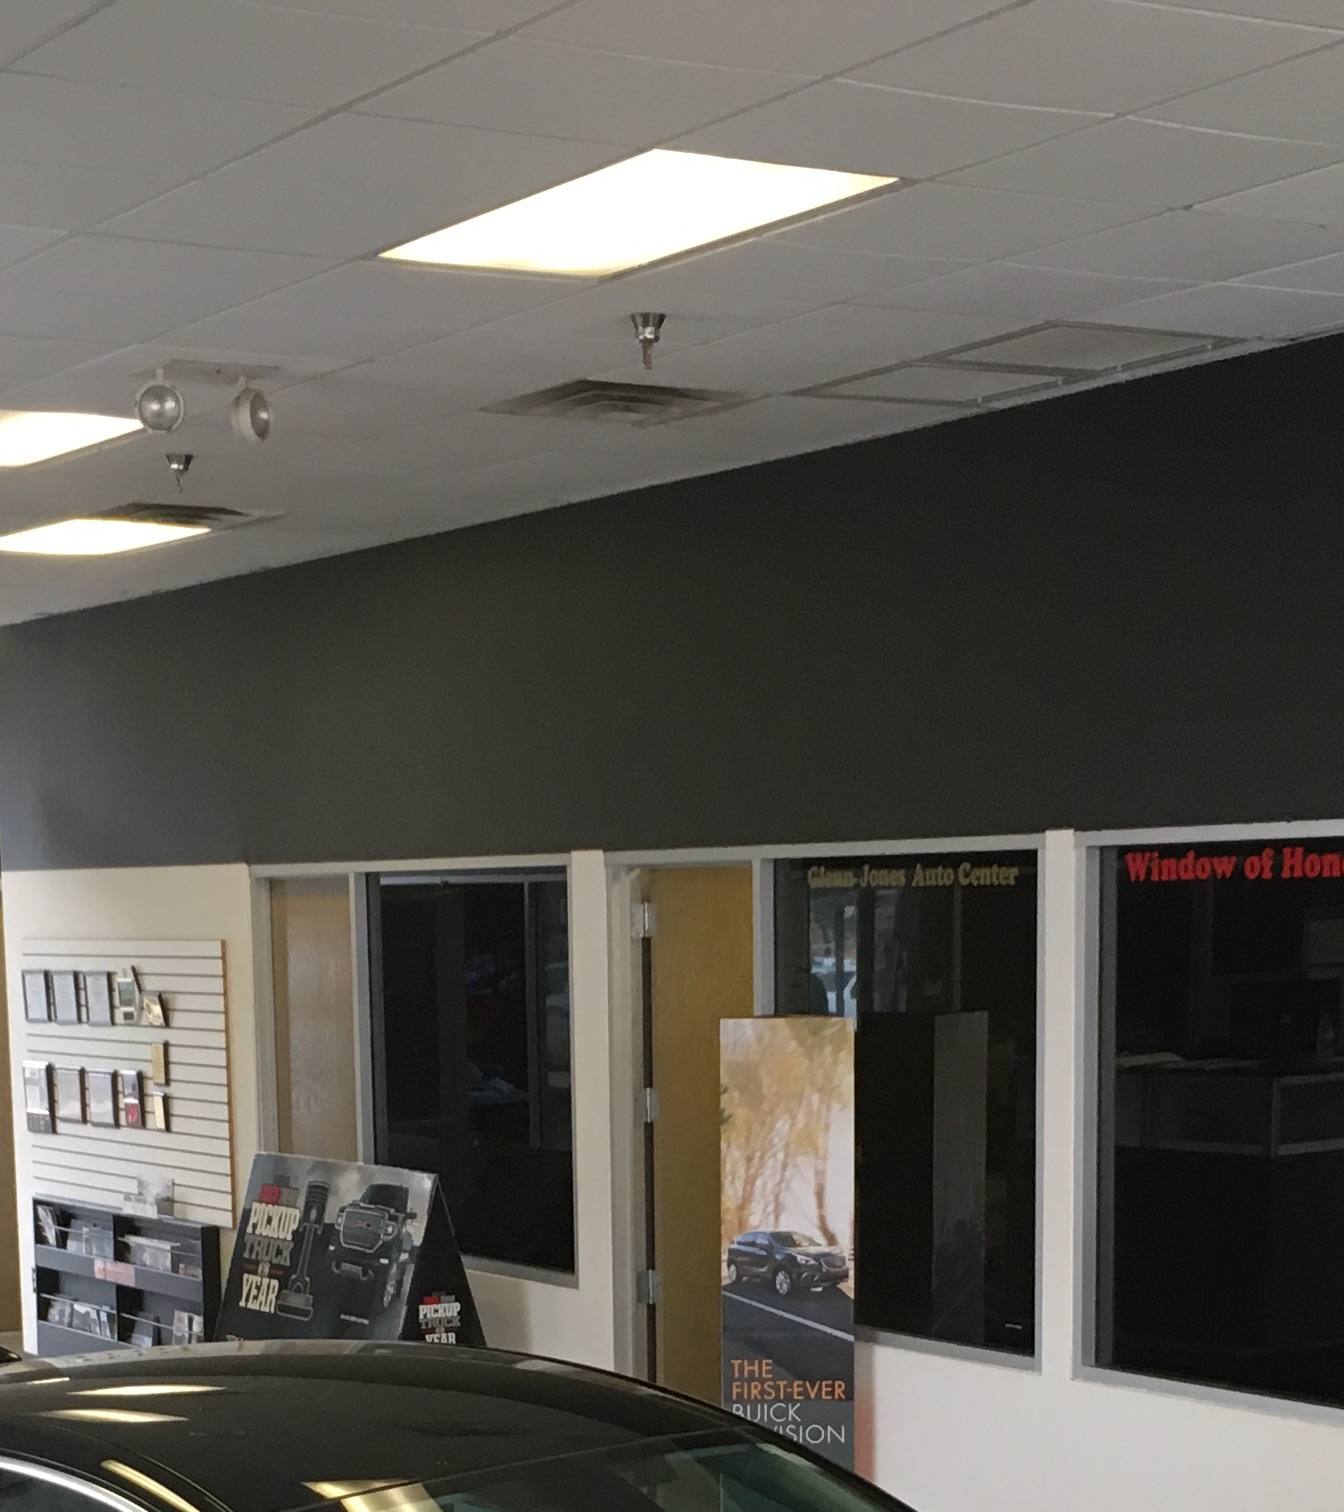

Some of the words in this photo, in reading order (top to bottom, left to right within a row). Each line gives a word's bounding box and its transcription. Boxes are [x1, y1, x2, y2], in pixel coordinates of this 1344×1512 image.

[860, 863, 905, 887] Jones
[912, 863, 955, 887] Auto
[958, 861, 1019, 887] Center
[1124, 850, 1237, 882] Window
[1244, 847, 1275, 880] of
[246, 1202, 301, 1240] PICKUP
[243, 1233, 294, 1266] TRUCK
[239, 1273, 279, 1313] YEAR
[419, 1302, 461, 1320] PICKUP
[730, 1359, 773, 1378] THE
[731, 1380, 846, 1400] FIRST-EVER
[732, 1402, 802, 1423] BUICK
[774, 1424, 846, 1444] ISION
